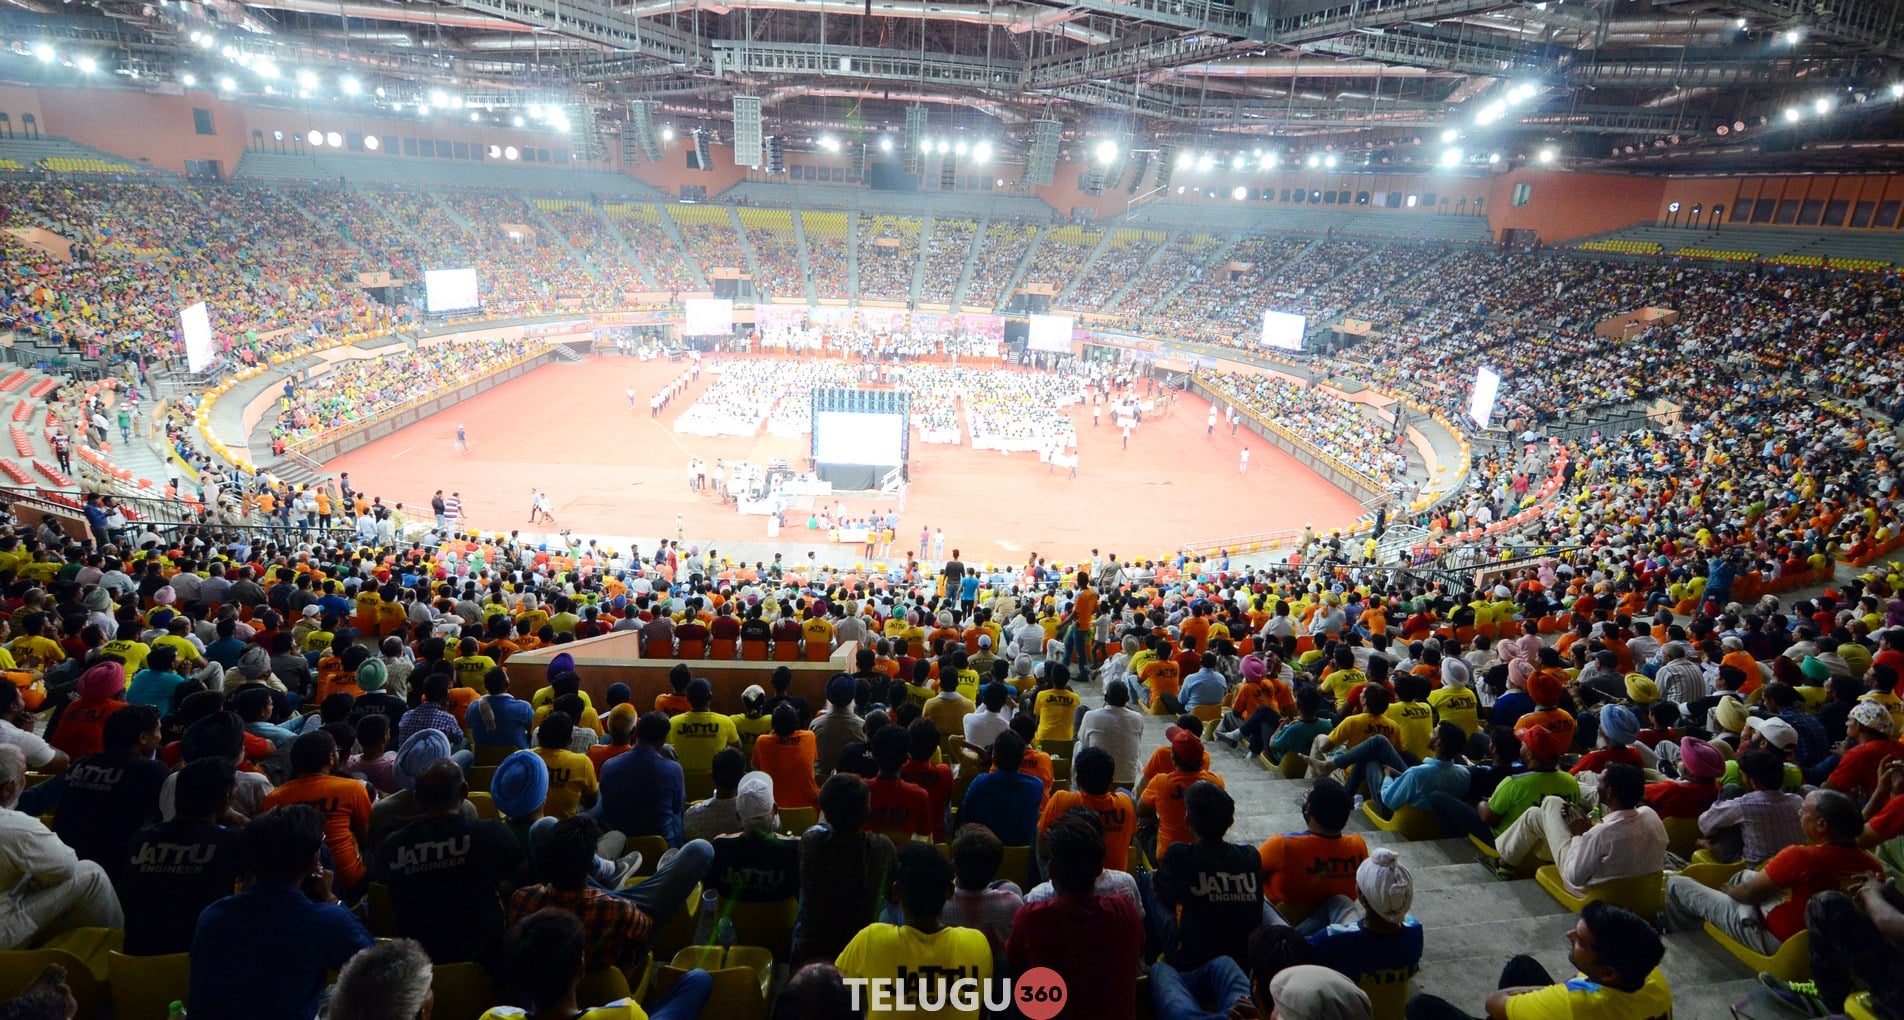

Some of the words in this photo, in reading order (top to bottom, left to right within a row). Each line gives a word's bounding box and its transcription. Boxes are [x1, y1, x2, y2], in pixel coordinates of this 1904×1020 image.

[1046, 695, 1074, 705] JATTU
[1446, 696, 1475, 708] JATTU
[1402, 707, 1430, 716] JATTU
[678, 723, 719, 735] JATTU
[65, 763, 124, 785] JATTU
[130, 841, 217, 865] JATTU
[389, 834, 471, 870] JATTU
[139, 864, 203, 874] ENGINEER
[404, 856, 466, 875] ENGINEER
[1189, 871, 1257, 896] JATTU
[1209, 892, 1257, 902] ENGINEER
